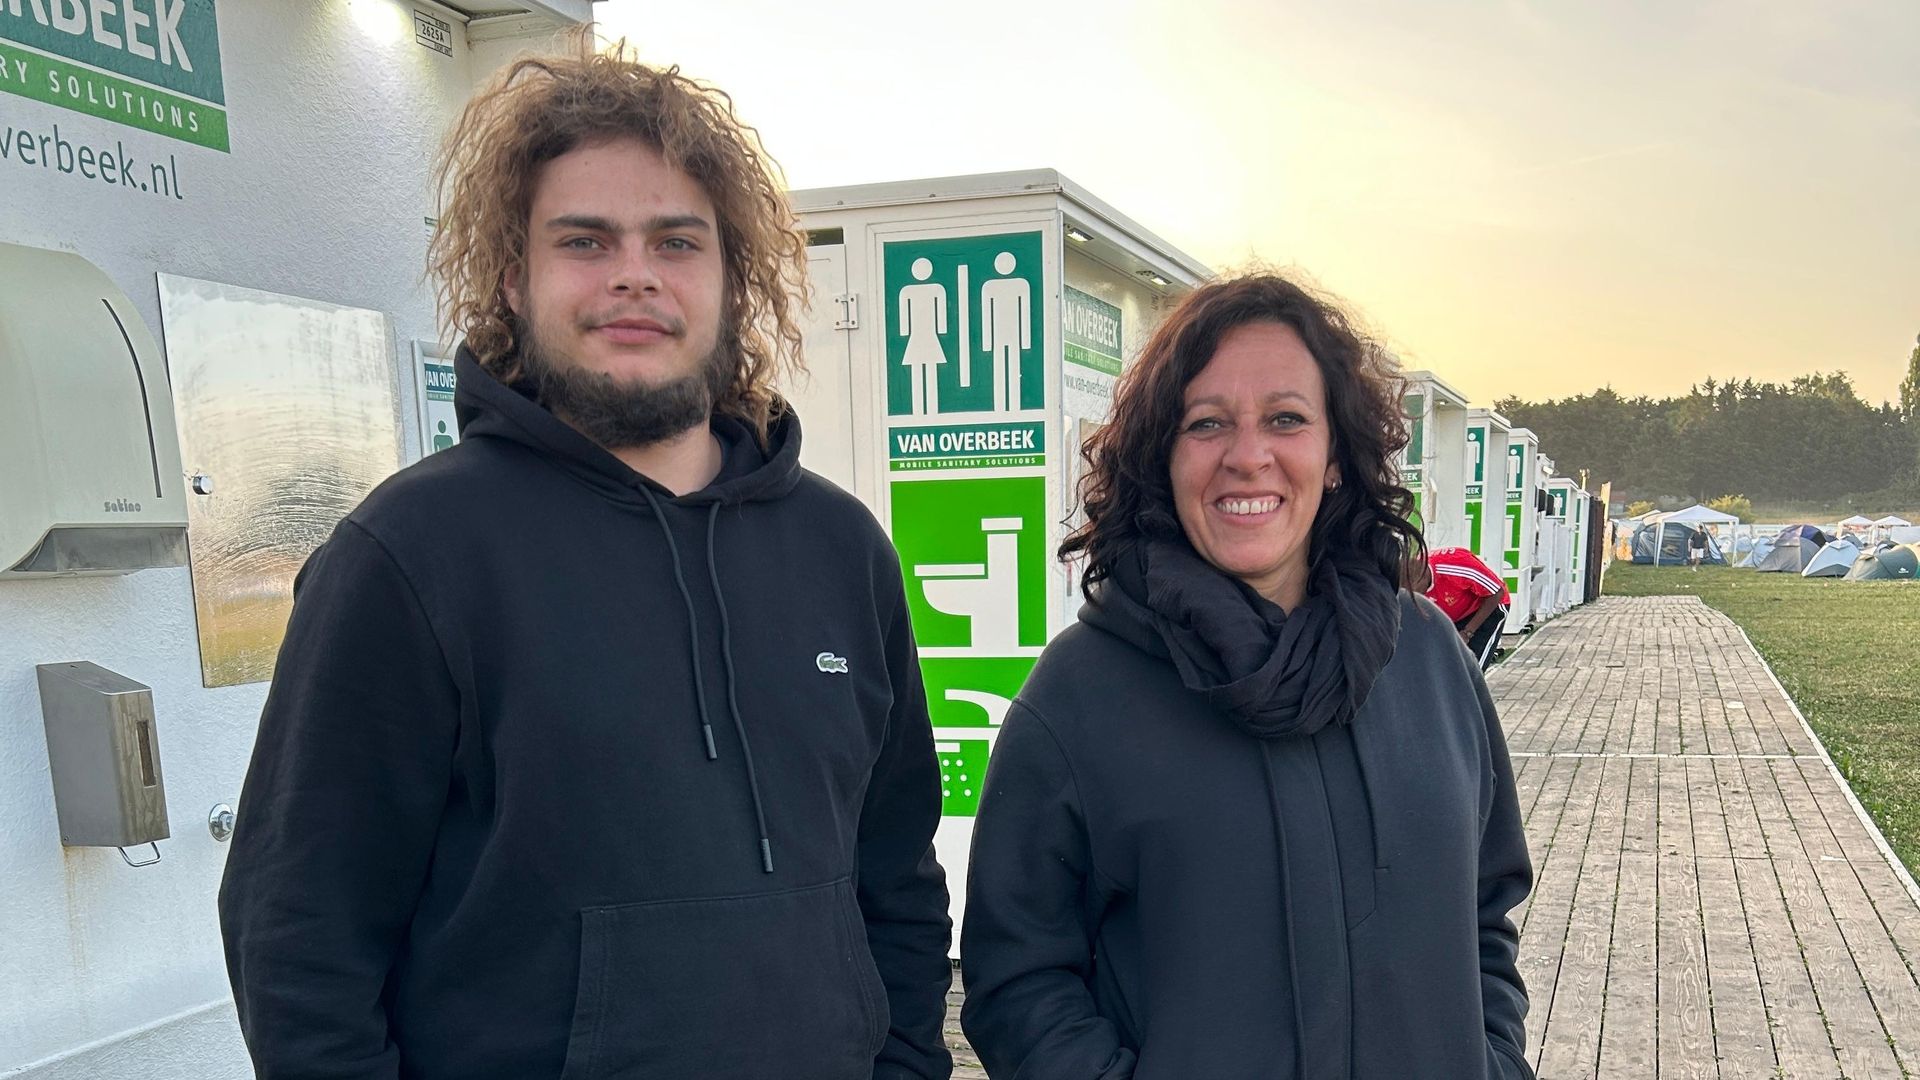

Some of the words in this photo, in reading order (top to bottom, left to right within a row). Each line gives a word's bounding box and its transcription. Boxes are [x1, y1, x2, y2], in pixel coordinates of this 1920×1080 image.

[0, 0, 193, 73] EEK
[422, 23, 444, 42] 2625A
[48, 70, 199, 133] SOLUTIONS
[1076, 304, 1118, 350] OVERBEEK
[440, 372, 456, 388] OVE
[897, 434, 934, 453] VAN
[939, 430, 1035, 452] OVERBEEK
[899, 460, 932, 469] MOBILE
[936, 458, 981, 467] SANITARY
[985, 457, 1036, 465] SOLUTIONS
[104, 498, 141, 512] Satino
